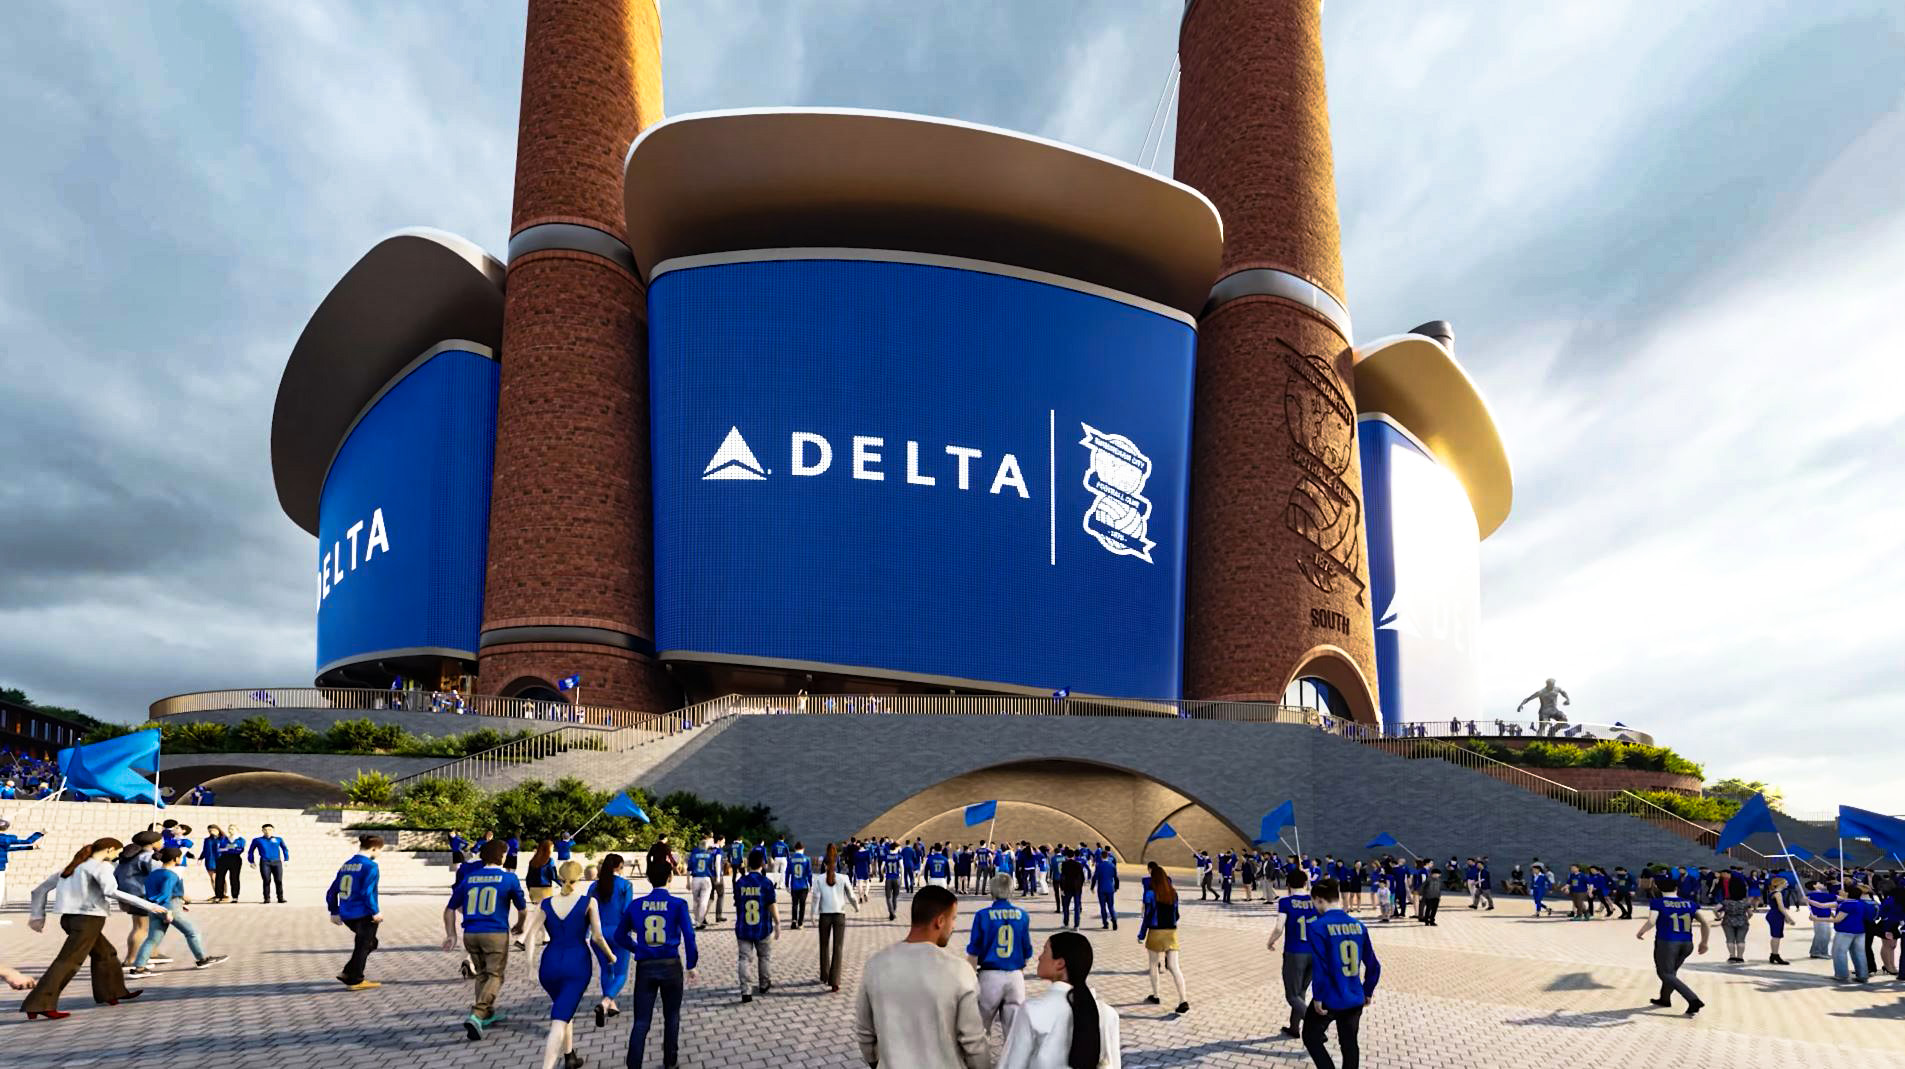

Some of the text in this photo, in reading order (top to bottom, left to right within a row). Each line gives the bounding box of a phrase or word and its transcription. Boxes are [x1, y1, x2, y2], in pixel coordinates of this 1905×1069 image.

[791, 431, 1030, 499] DELTA
[1311, 608, 1350, 636] SOUTH
[339, 874, 354, 900] 9
[741, 886, 761, 897] PAIK
[467, 886, 498, 915] 10
[642, 900, 668, 911] PAIK
[745, 900, 760, 925] 8
[1291, 899, 1314, 909] SCOT
[1663, 900, 1691, 908] SCOTT
[644, 915, 667, 947] 8
[1327, 923, 1363, 936] KYOGO
[1670, 913, 1691, 932] 11
[996, 924, 1014, 958] 9
[1340, 940, 1359, 976] 9
